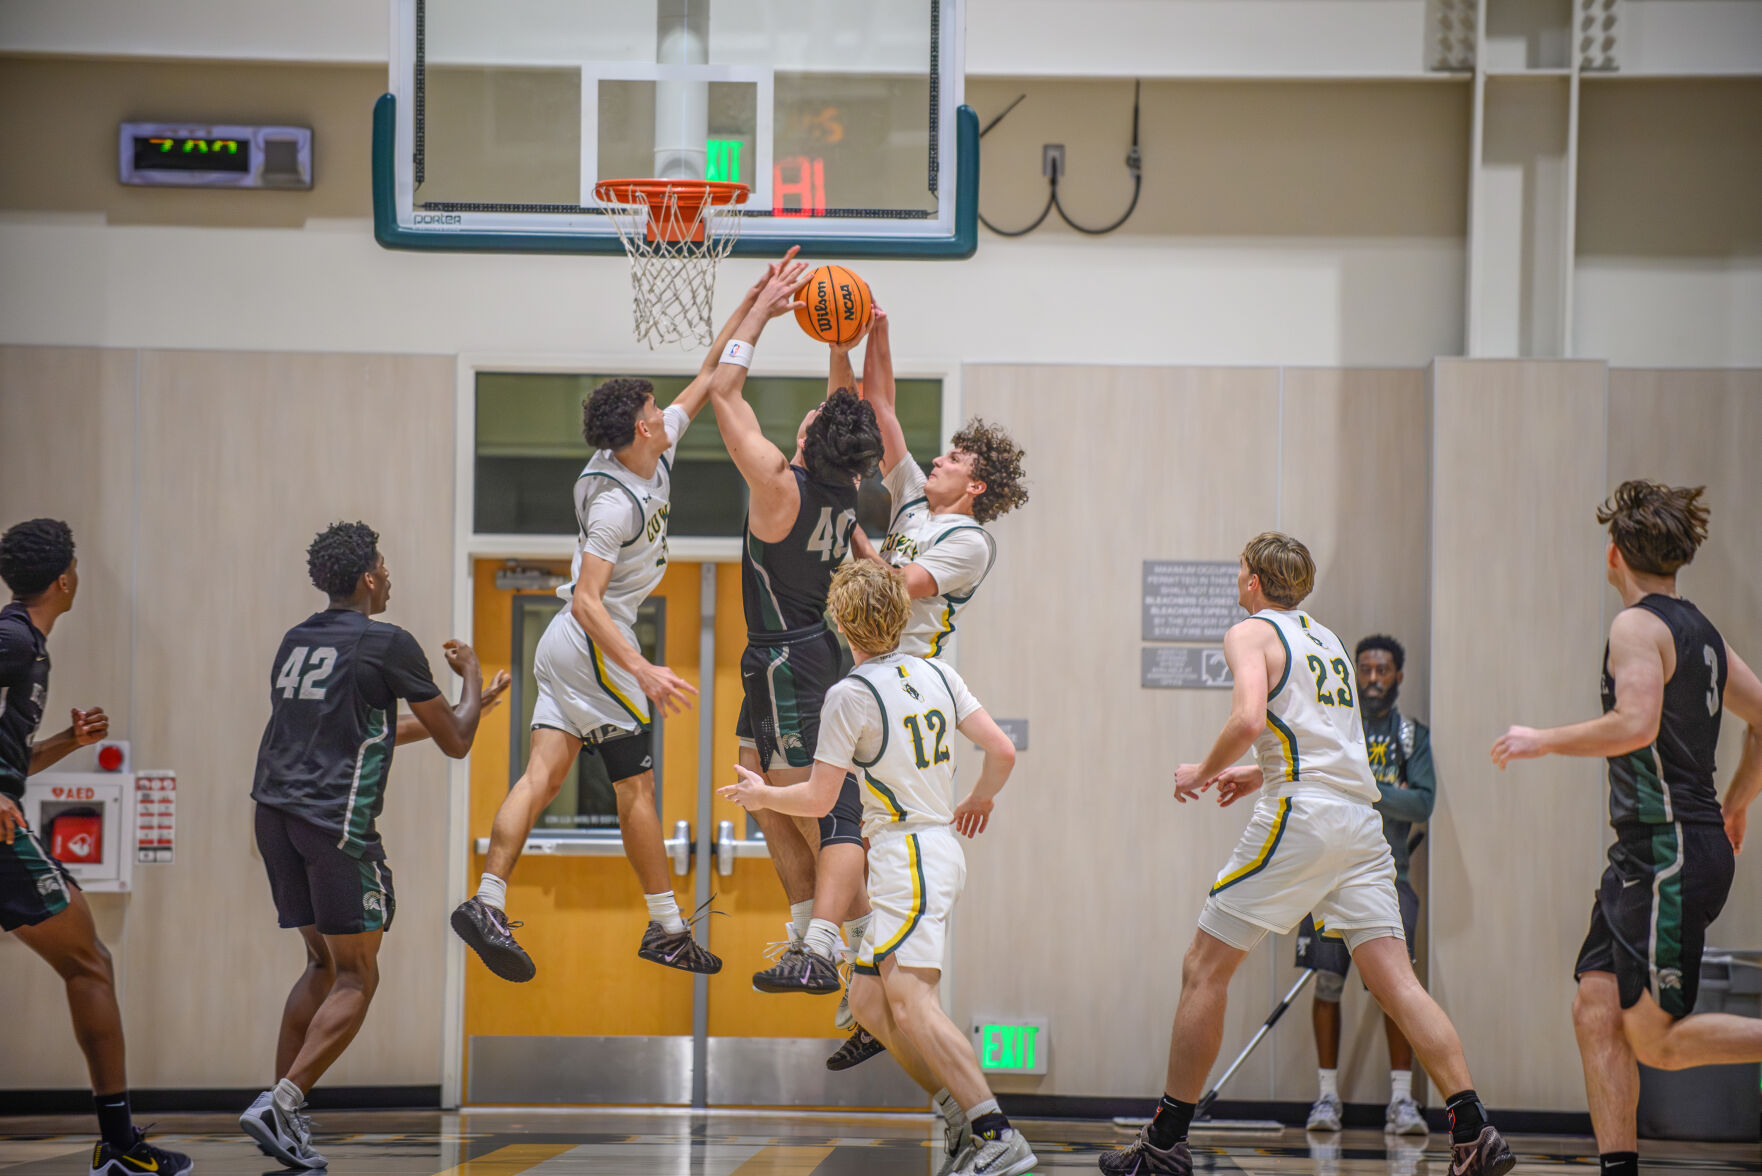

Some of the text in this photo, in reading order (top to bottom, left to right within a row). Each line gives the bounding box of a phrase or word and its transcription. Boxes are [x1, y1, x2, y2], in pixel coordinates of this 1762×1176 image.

[706, 138, 744, 183] XIT
[815, 280, 833, 333] Wilson
[840, 284, 855, 321] NCAA
[1147, 576, 1198, 585] PERMITTED
[1199, 576, 1209, 585] IN
[1160, 586, 1187, 595] SHALL
[1188, 586, 1207, 595] NOT
[1145, 596, 1197, 605] BLEACHERS
[1150, 606, 1202, 615] BLEACHERS
[1203, 606, 1229, 616] OPEN
[1153, 617, 1165, 626] BY
[1168, 617, 1184, 626] THE
[1153, 627, 1181, 636] STATE
[275, 646, 338, 700] 42
[1305, 653, 1354, 709] 23
[1702, 643, 1720, 718] 3
[902, 708, 951, 770] 12
[66, 788, 95, 800] AED
[982, 1024, 1040, 1069] EXIT
